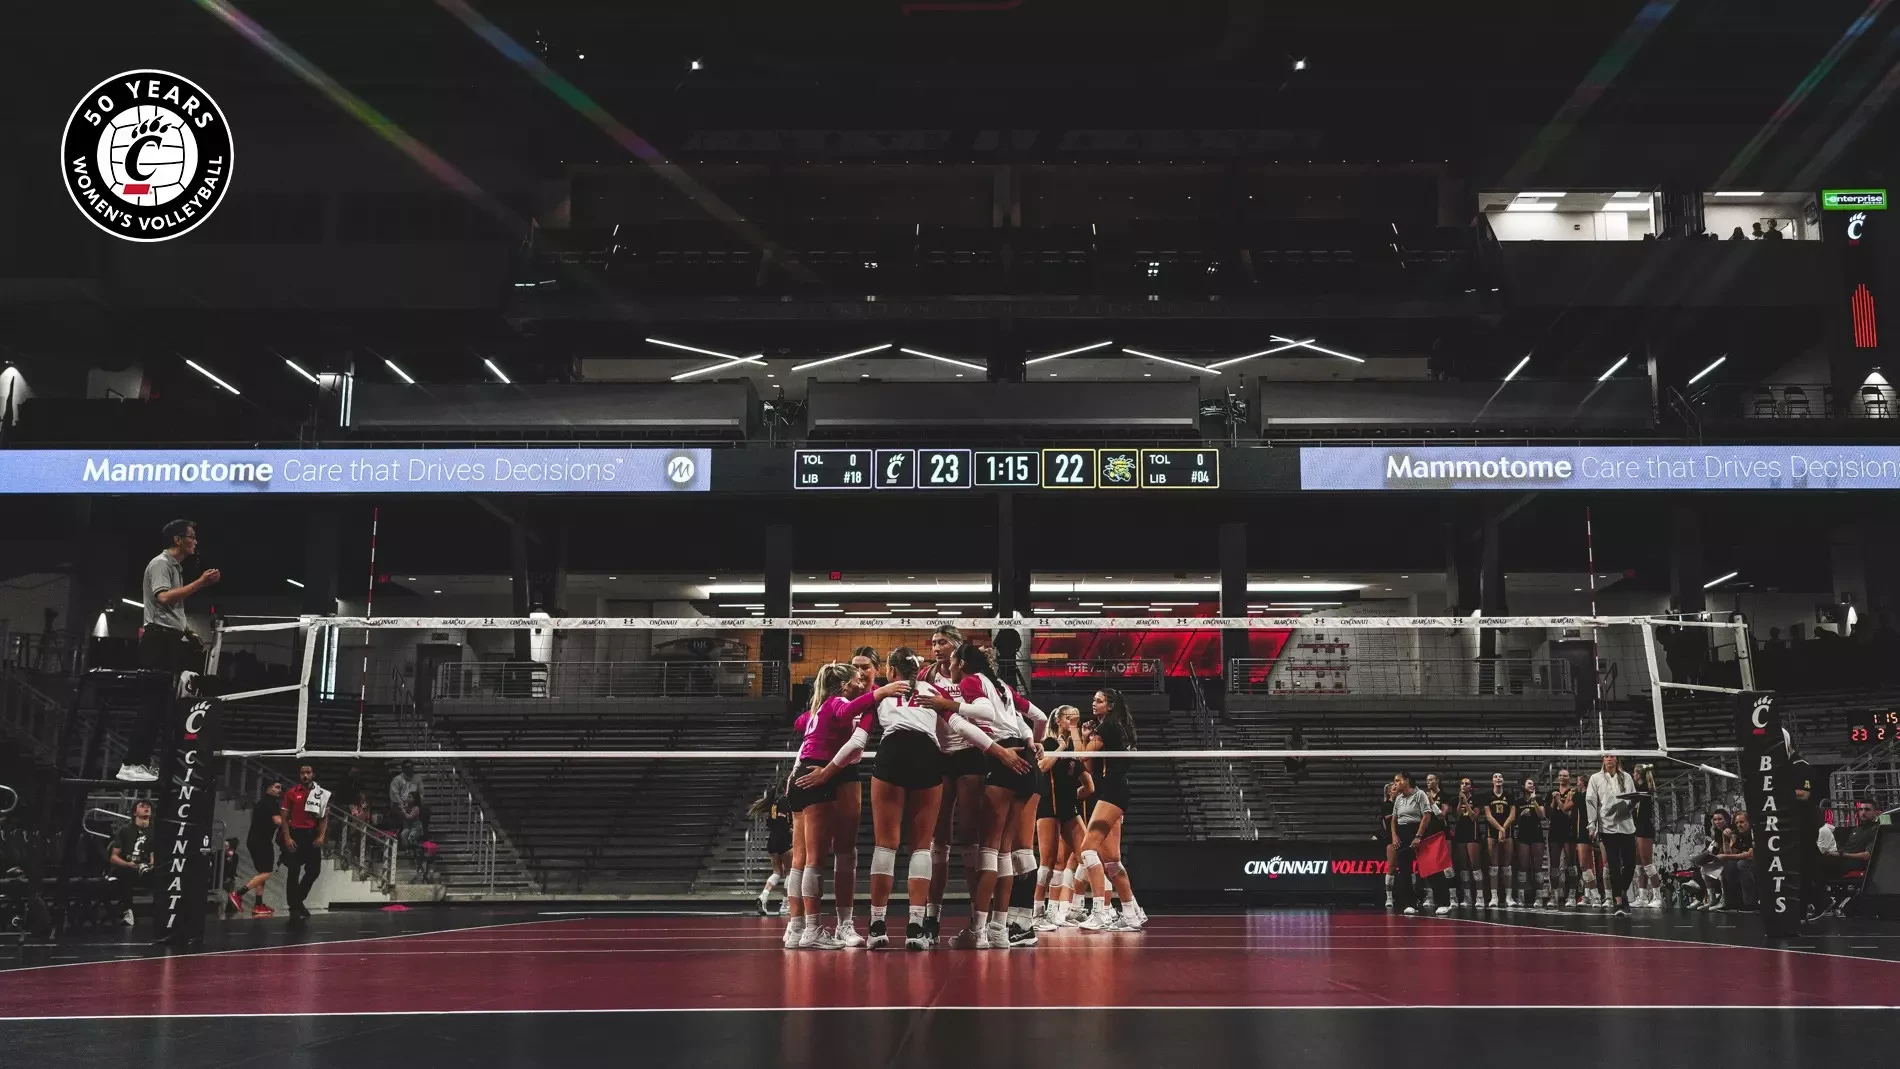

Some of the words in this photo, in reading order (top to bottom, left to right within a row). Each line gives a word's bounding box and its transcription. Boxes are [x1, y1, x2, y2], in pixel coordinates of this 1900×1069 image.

[1828, 194, 1883, 204] enterprise
[82, 457, 274, 483] Mammotome
[283, 458, 342, 483] Care
[349, 458, 402, 483] that
[408, 457, 485, 482] Drives
[802, 454, 823, 465] TOL
[849, 453, 857, 467] 0
[930, 454, 959, 484] 23
[986, 456, 1029, 482] 1:15
[1055, 453, 1084, 483] 22
[1149, 454, 1171, 465] TOL
[1197, 453, 1204, 467] 0
[1386, 455, 1572, 479] Mammotome
[1581, 455, 1639, 478] Care
[1646, 455, 1697, 478] that
[1705, 455, 1782, 478] Drives
[802, 472, 818, 484] LIB
[843, 470, 862, 484] #18
[1149, 473, 1166, 484] LIB
[1191, 470, 1210, 484] #04
[721, 619, 745, 627] BEARCATS
[788, 619, 816, 627] CINCINNATI
[859, 619, 884, 627] BEARCATS
[997, 619, 1022, 627] BEARCATS
[1064, 619, 1093, 627] CINCINNATI
[1136, 619, 1160, 627] BEARCATS
[1851, 728, 1868, 742] 23
[1877, 728, 1885, 740] 2
[166, 749, 198, 929] CINCINNATI
[1759, 754, 1787, 914] BEARCATS
[1244, 857, 1328, 877] CINCINNATI
[1332, 860, 1419, 876] VOLLEY
